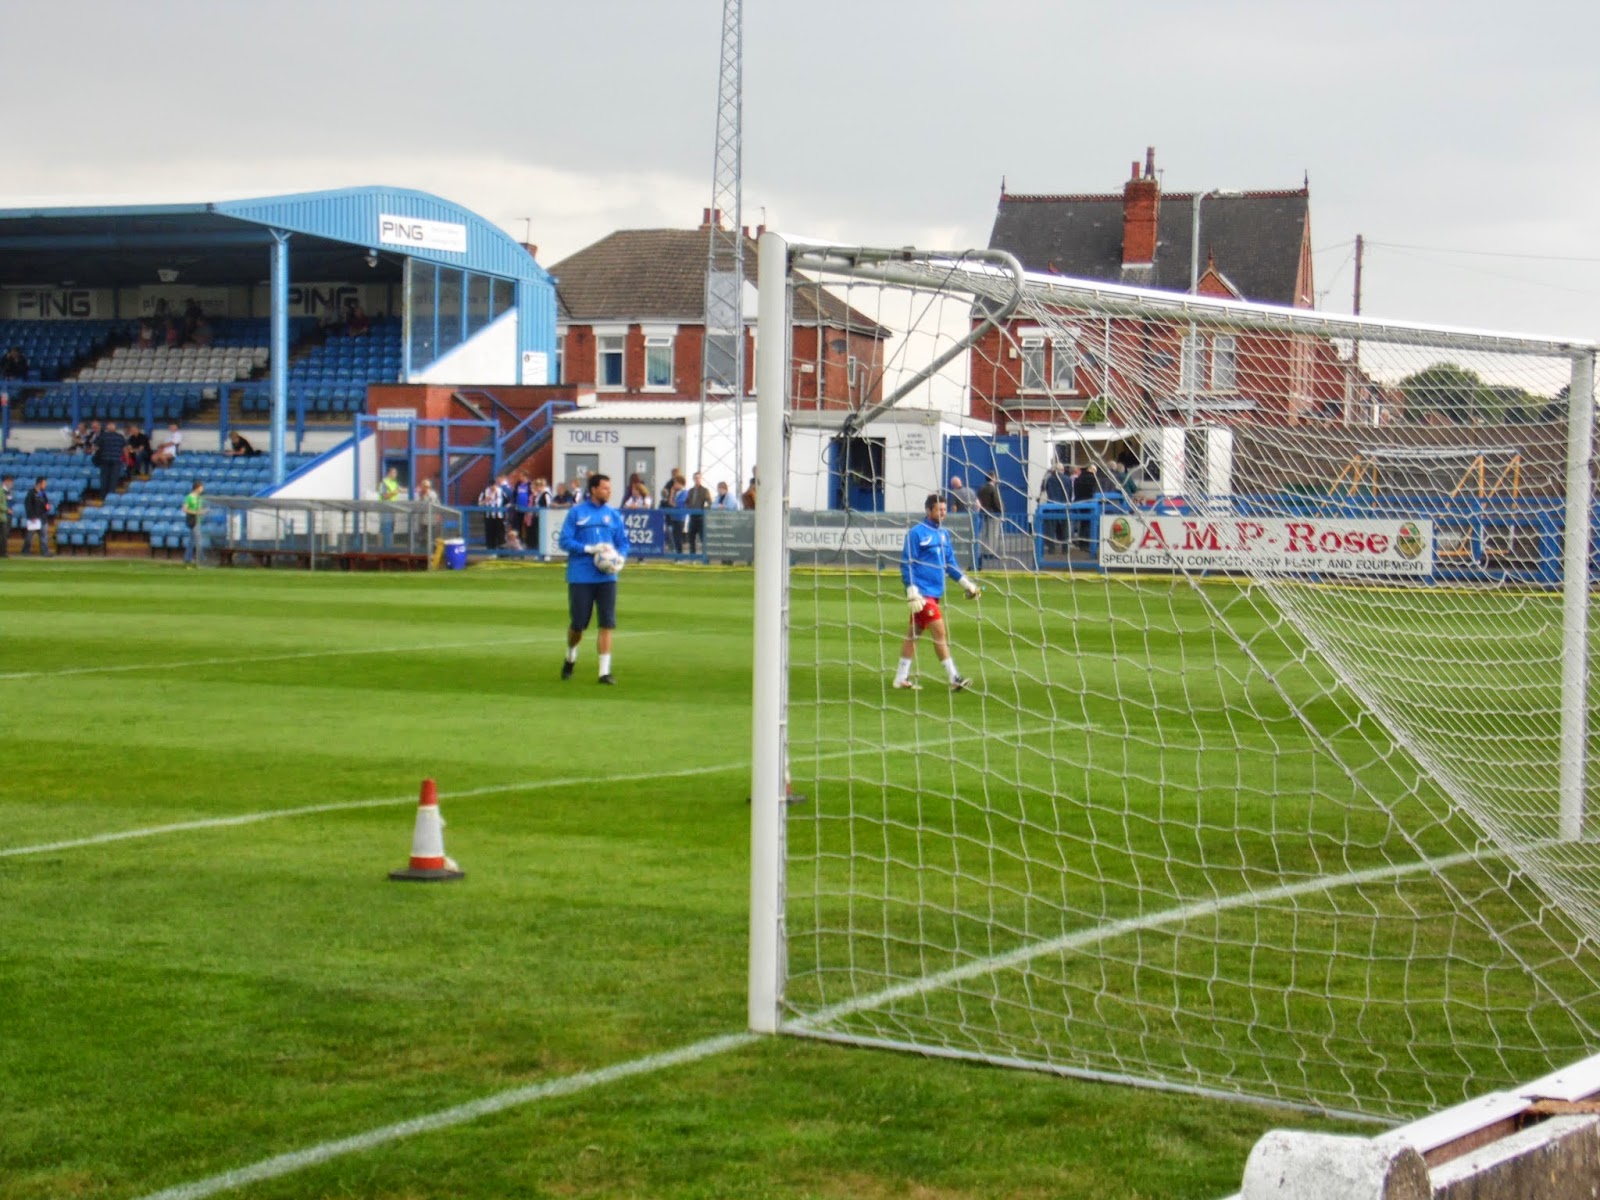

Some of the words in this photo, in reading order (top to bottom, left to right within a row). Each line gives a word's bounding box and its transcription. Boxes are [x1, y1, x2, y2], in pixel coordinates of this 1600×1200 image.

[382, 221, 424, 241] PING
[17, 290, 90, 317] PING
[568, 430, 619, 443] TOILETS
[864, 532, 904, 546] LIMITE
[1102, 554, 1170, 565] SPECIALISTS
[1327, 558, 1353, 569] AND
